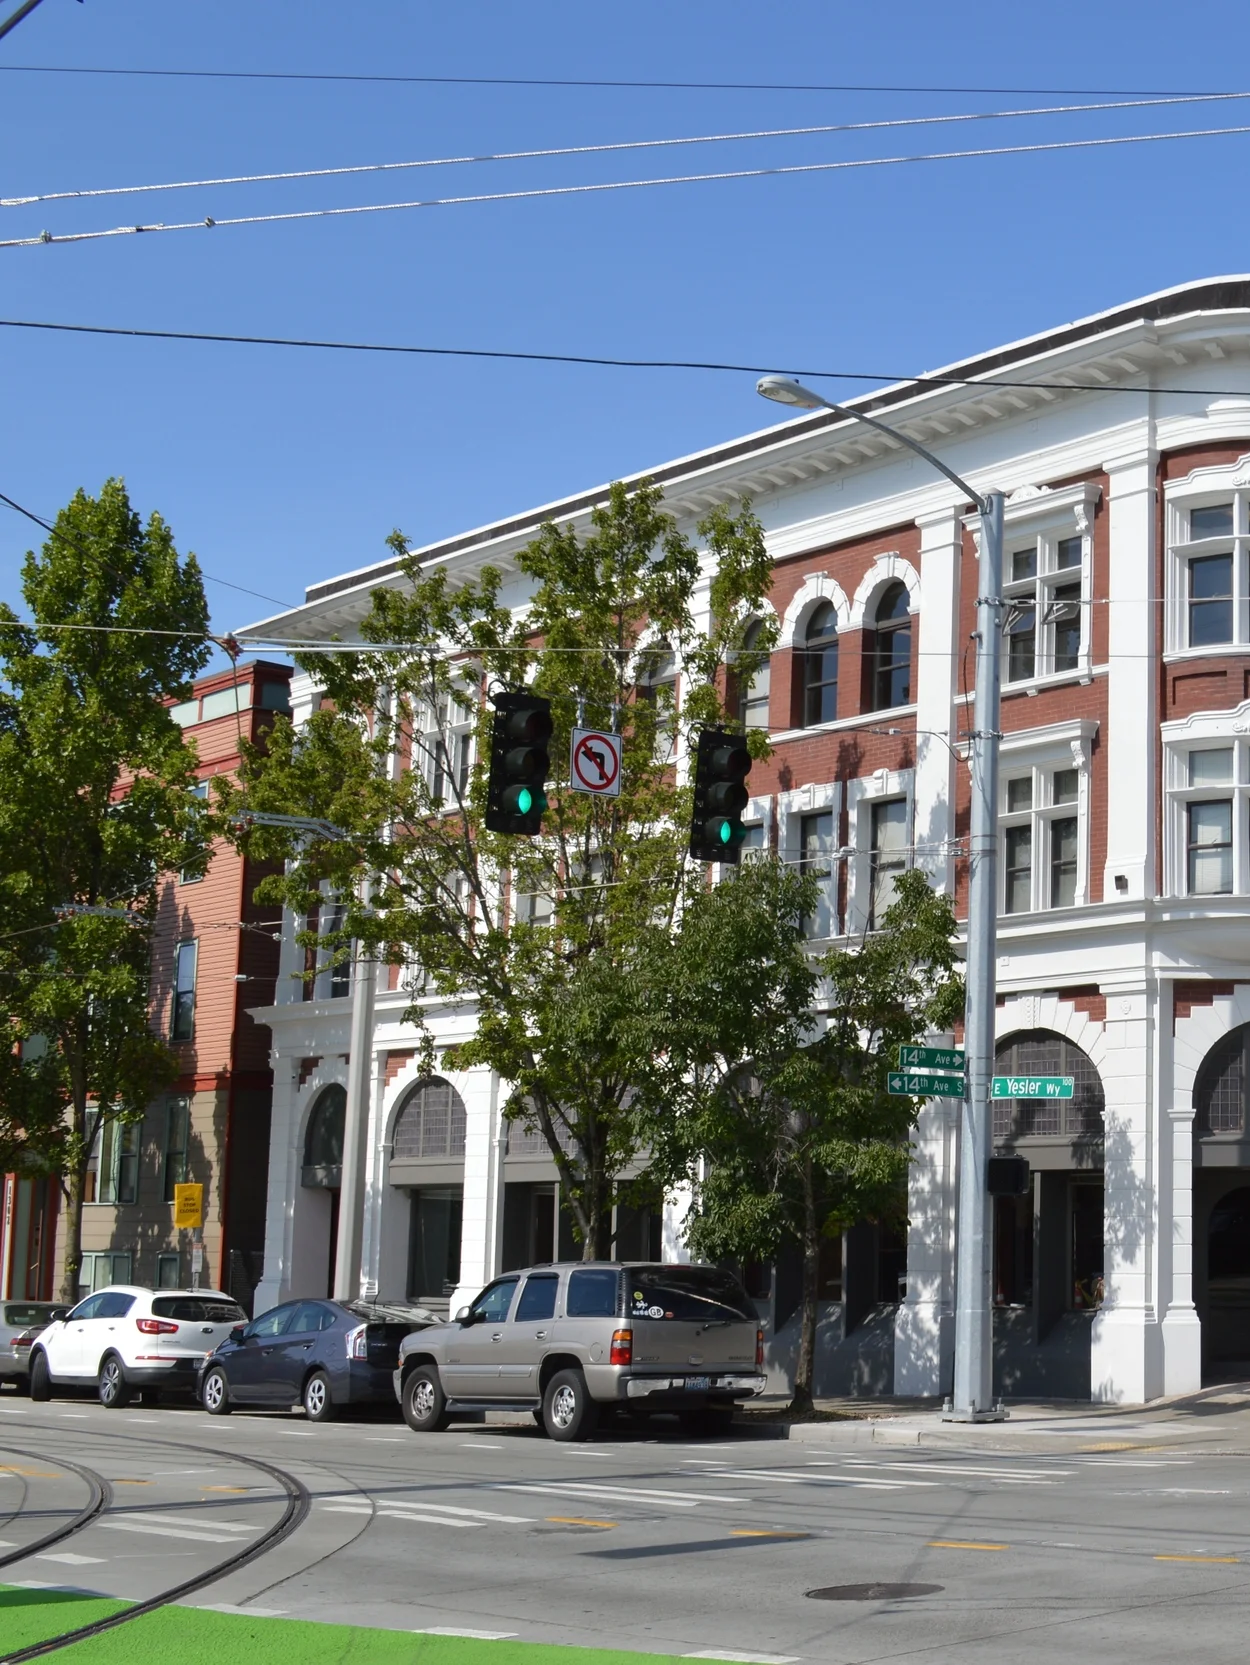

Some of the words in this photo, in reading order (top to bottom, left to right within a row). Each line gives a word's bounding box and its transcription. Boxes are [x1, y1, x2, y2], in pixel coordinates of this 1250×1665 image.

[902, 1048, 927, 1065] 14th
[934, 1053, 950, 1065] Ave
[903, 1076, 929, 1092] 14th
[933, 1080, 949, 1092] Ave
[956, 1081, 963, 1092] S
[994, 1083, 1001, 1094] E
[1006, 1078, 1041, 1095] Yesler
[1046, 1083, 1061, 1097] Wy
[1062, 1078, 1073, 1086] 100
